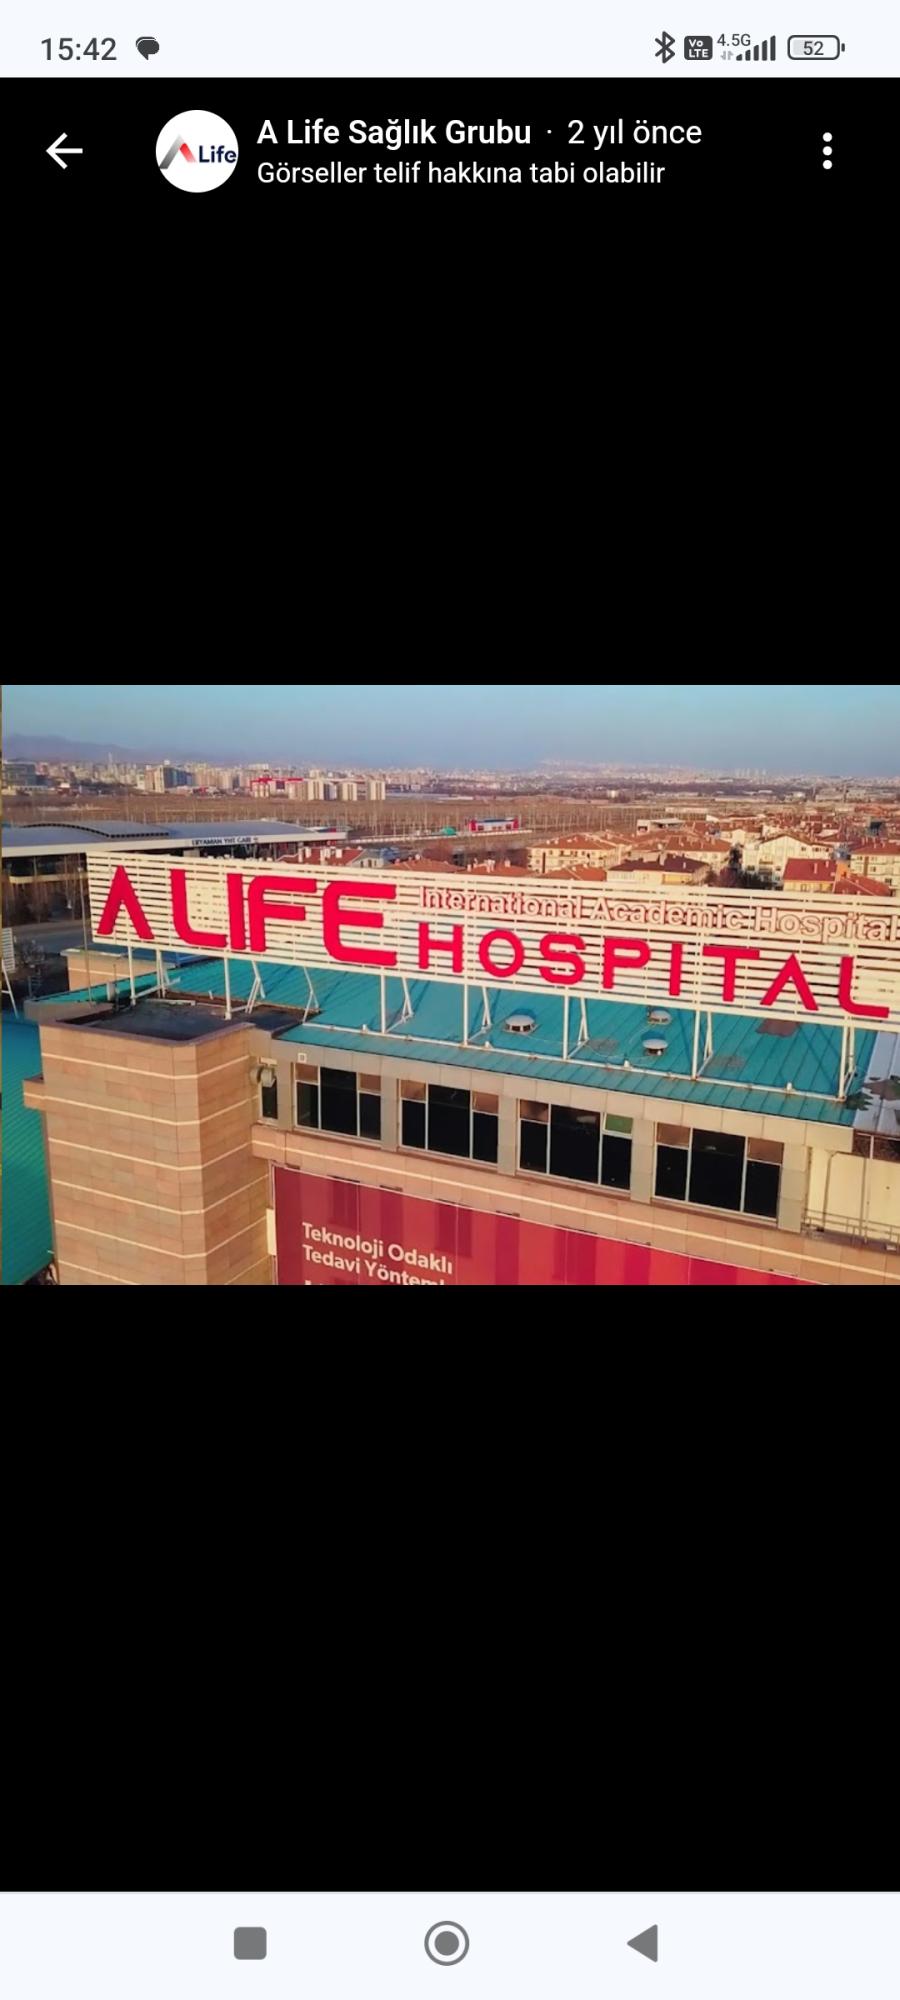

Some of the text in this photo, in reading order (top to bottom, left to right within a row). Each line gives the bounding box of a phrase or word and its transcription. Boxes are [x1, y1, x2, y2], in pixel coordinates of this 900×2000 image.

[96, 864, 398, 966] A LIFE
[418, 885, 899, 944] International Academic Hospital
[418, 921, 890, 1019] HOSPITAL
[302, 1222, 453, 1275] Teknoloji Odaklı
[302, 1244, 361, 1274] Tedavi
